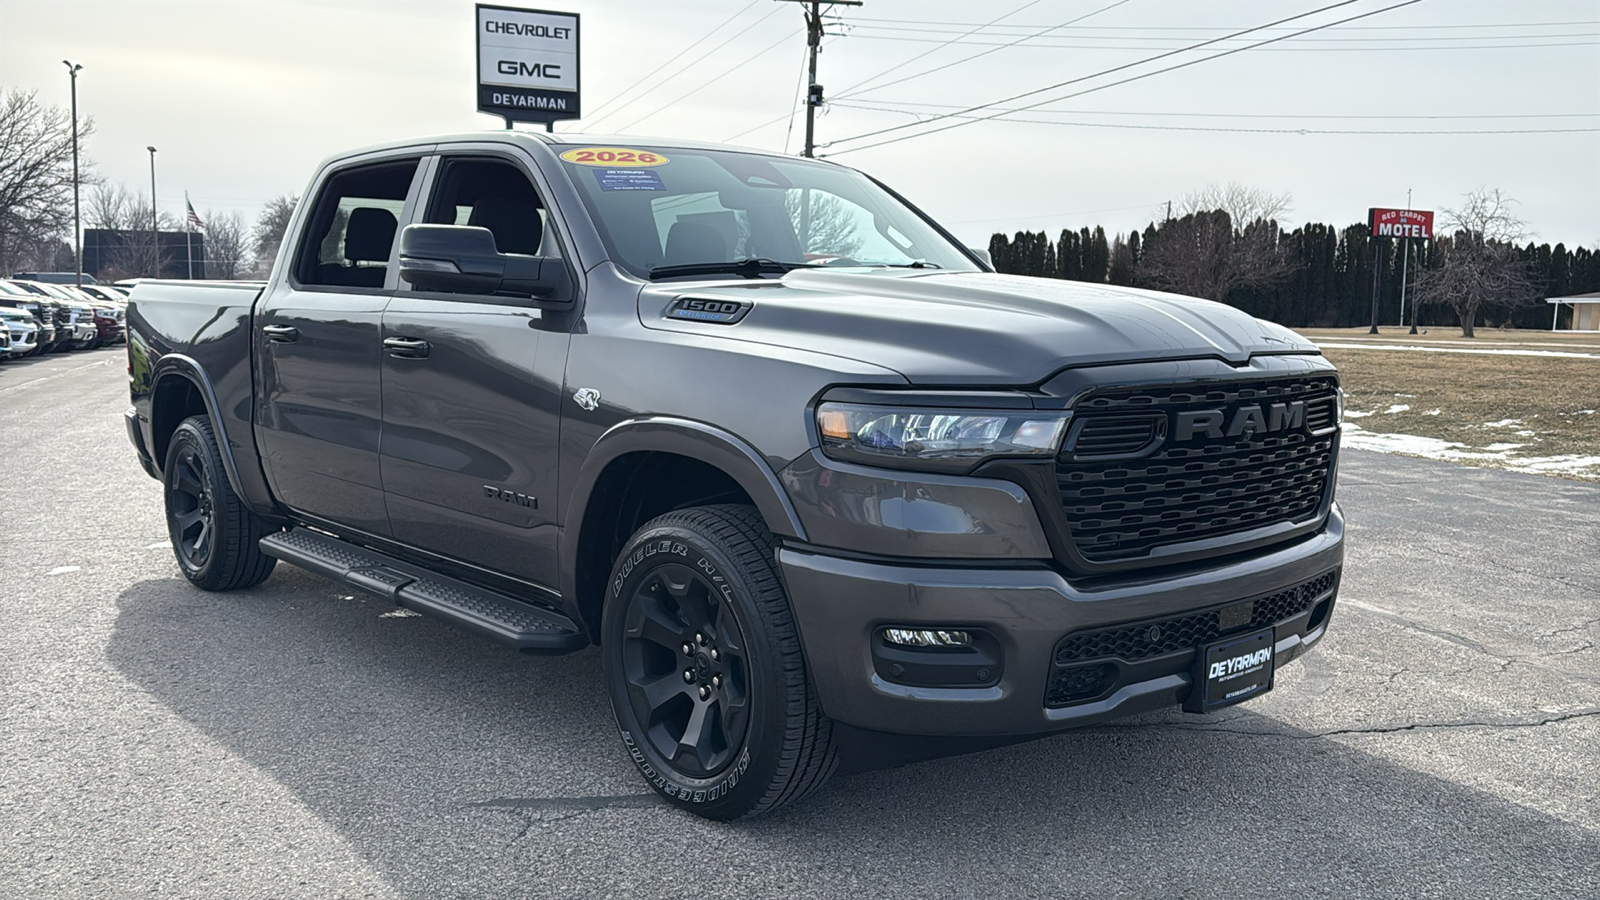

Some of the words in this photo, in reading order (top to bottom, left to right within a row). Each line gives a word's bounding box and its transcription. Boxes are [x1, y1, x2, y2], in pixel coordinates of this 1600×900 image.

[486, 20, 572, 40] CHEVROLET
[497, 60, 561, 79] GMC
[493, 93, 566, 110] DEYARMAN
[575, 151, 658, 163] 2026
[1381, 211, 1397, 221] RED
[1399, 211, 1426, 223] CARPET
[1379, 223, 1429, 238] MOTEL
[682, 300, 738, 313] 1500
[1175, 400, 1304, 441] RAM
[483, 484, 539, 510] RAM
[613, 540, 688, 598] DUELER
[1208, 646, 1272, 679] DEYARMAN
[622, 731, 751, 803] BRIDGESTONE
